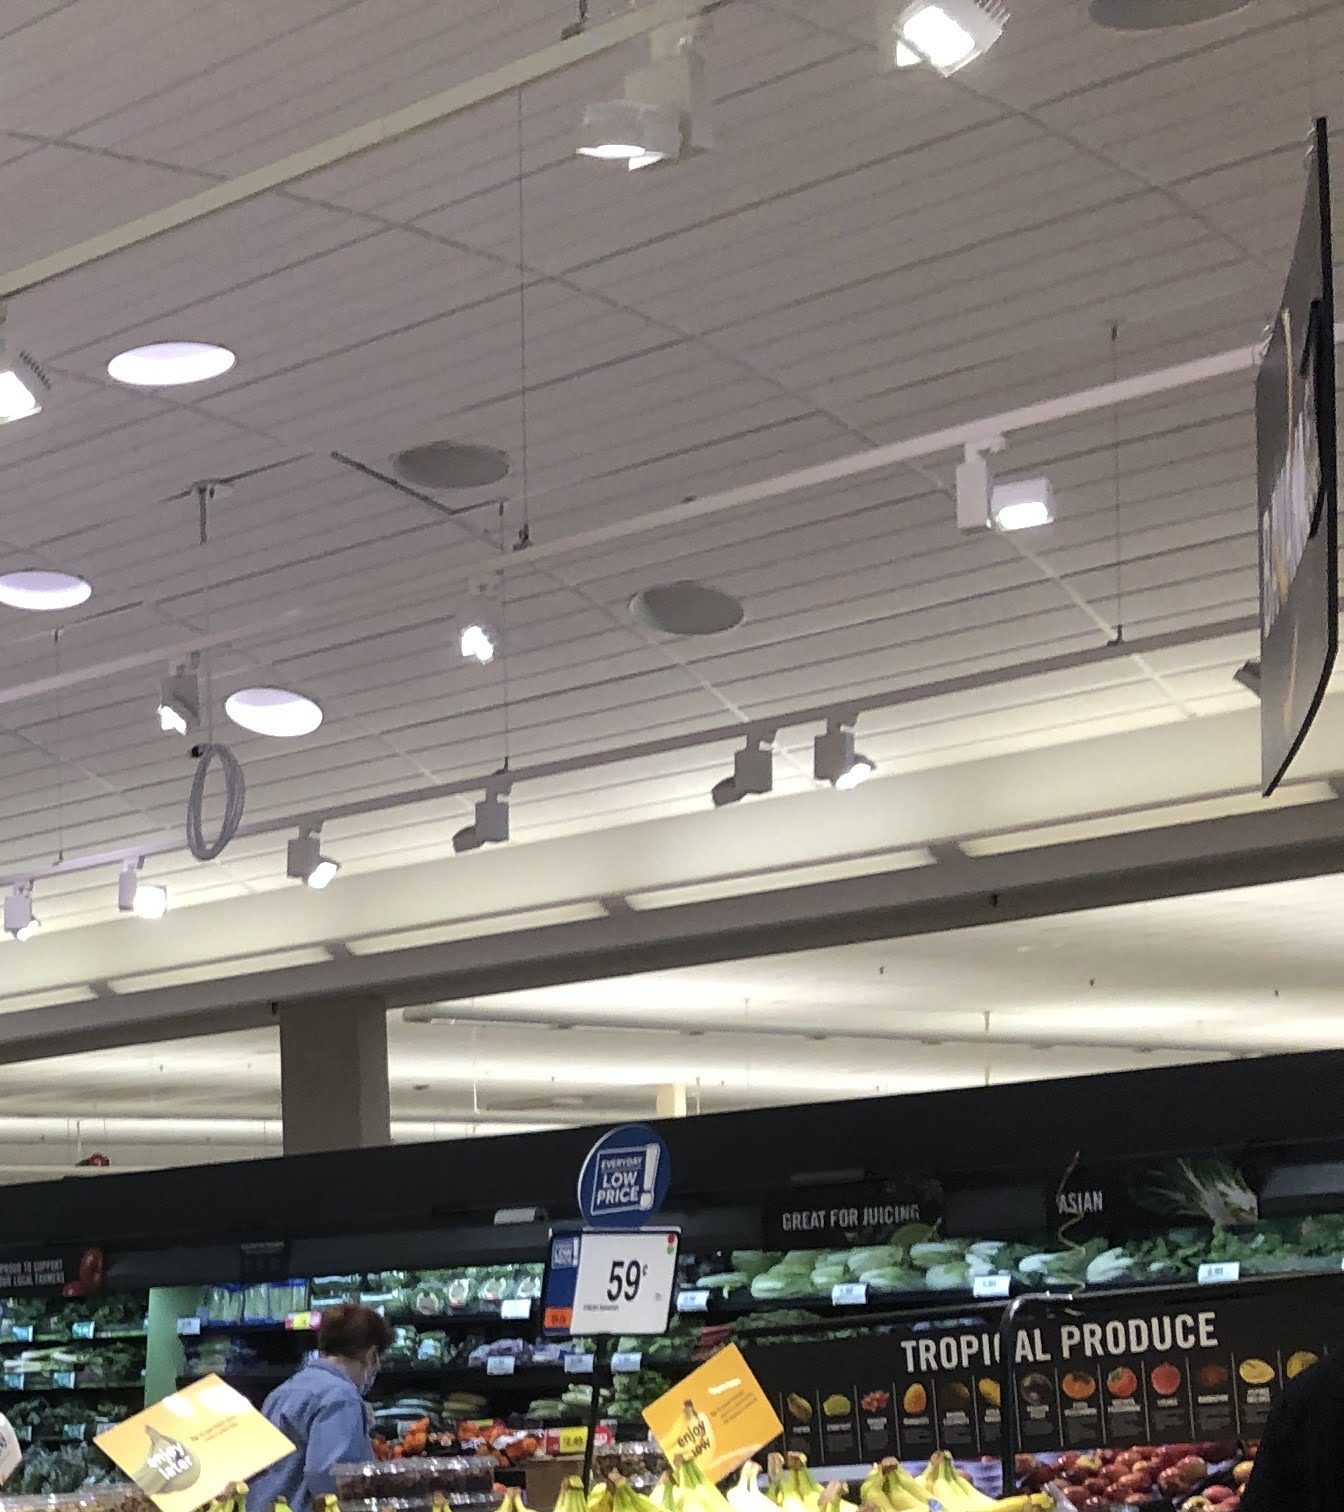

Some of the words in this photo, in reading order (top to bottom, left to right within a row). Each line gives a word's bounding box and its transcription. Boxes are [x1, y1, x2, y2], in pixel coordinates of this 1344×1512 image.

[603, 1171, 637, 1188] LOW
[596, 1186, 640, 1206] PRICE
[1058, 1190, 1103, 1214] ASIAN
[782, 1209, 826, 1232] GREAT
[830, 1207, 859, 1228] FOR
[862, 1203, 920, 1227] JUICING
[1061, 1311, 1219, 1360] PRODUCE
[677, 1420, 707, 1448] enjoy
[146, 1443, 185, 1469] enjoy
